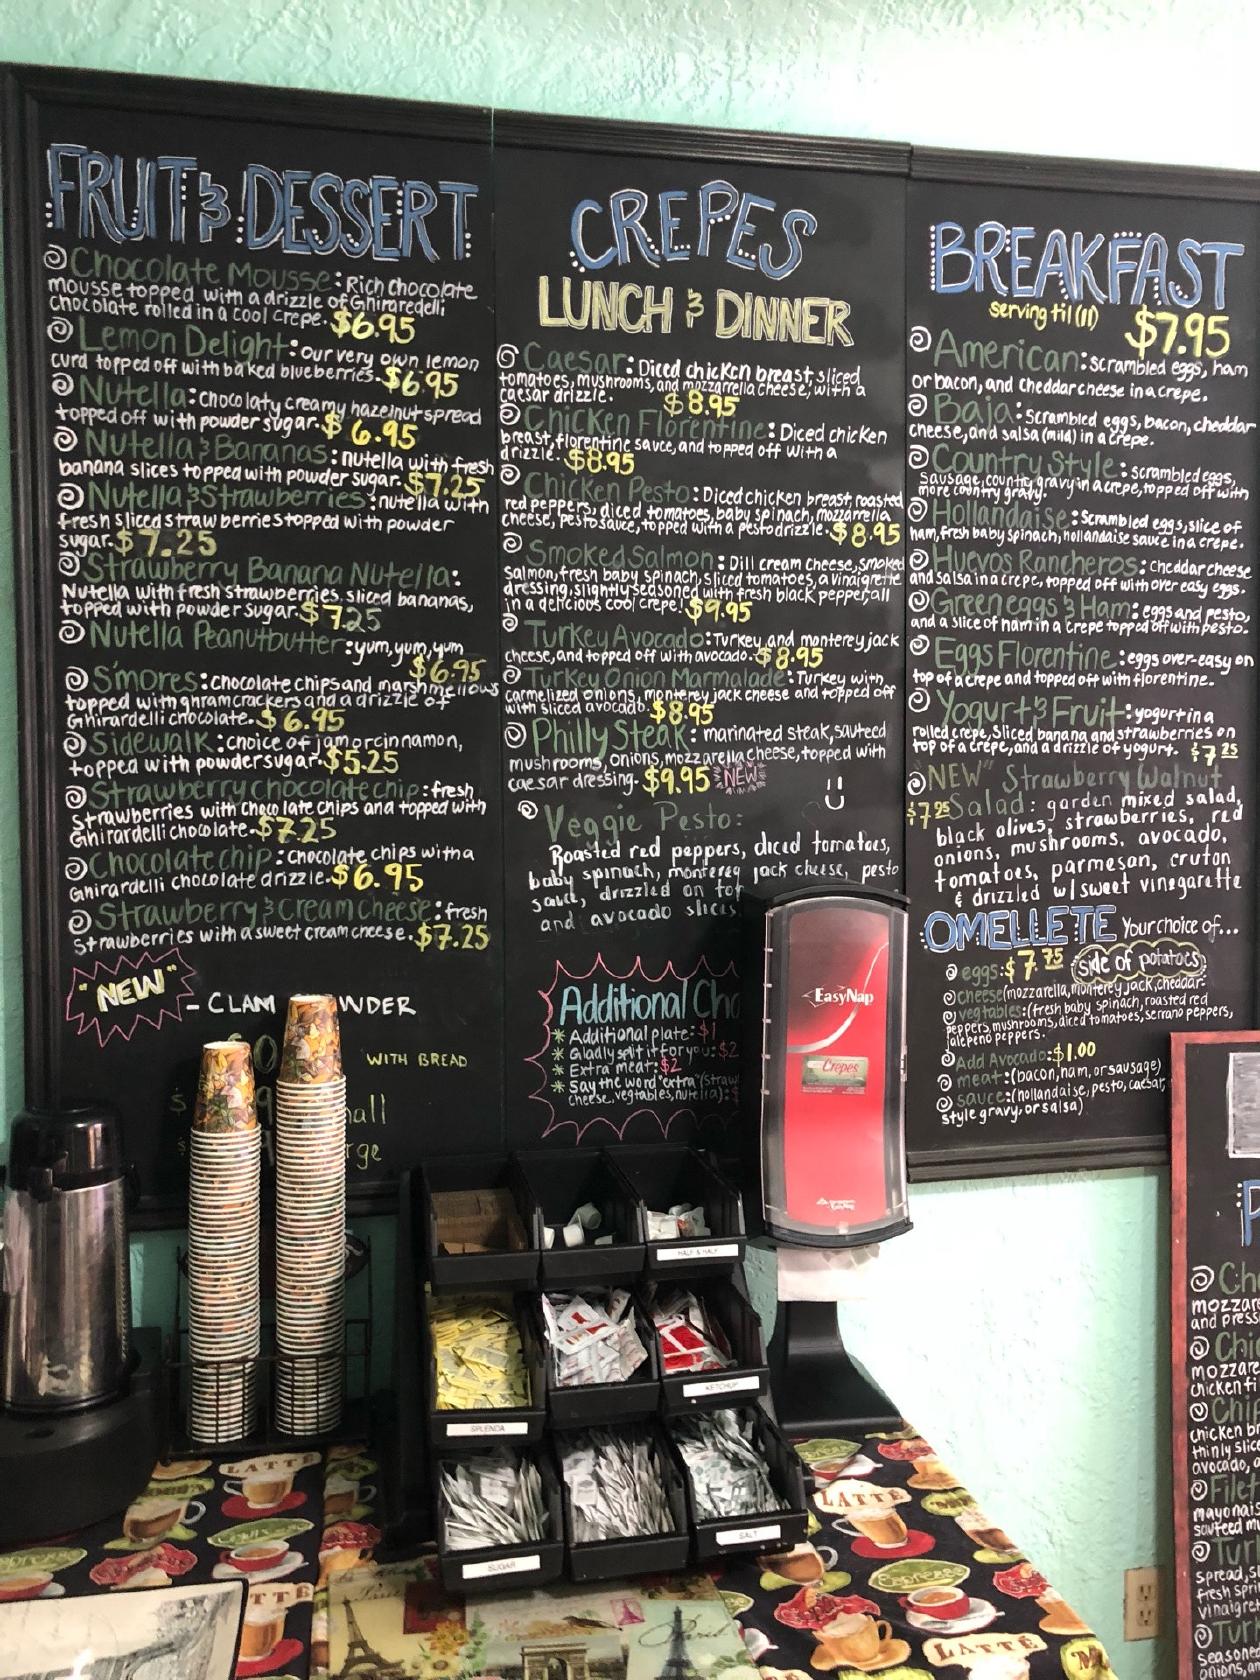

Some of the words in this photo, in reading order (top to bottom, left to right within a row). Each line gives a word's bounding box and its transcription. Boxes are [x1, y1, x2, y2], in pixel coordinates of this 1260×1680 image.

[46, 143, 198, 244] FRUIT
[240, 162, 479, 263] DESSERT
[569, 179, 817, 281] CREPES
[70, 246, 220, 286] Chocolate
[346, 275, 385, 295] Rich
[388, 276, 479, 300] chocolate
[932, 220, 1245, 310] BREAKFAST
[50, 294, 140, 317] chocolate
[330, 307, 416, 344] $6.95
[538, 275, 674, 334] LUNCH
[716, 288, 855, 346] DINNER
[989, 301, 1048, 331] serving
[1050, 303, 1072, 325] til
[79, 315, 176, 354] Lemon
[337, 348, 374, 369] very
[426, 354, 480, 371] lemon
[1124, 303, 1231, 360] $7.95
[51, 353, 88, 370] curd
[96, 354, 150, 375] topped
[380, 364, 460, 400] $6.95
[639, 358, 682, 378] Diced
[685, 361, 752, 381] chicken
[1212, 360, 1249, 378] ham
[1019, 377, 1076, 396] cheddar
[1077, 381, 1125, 397] cheese
[285, 397, 346, 423] creamy
[663, 388, 741, 418] $8.95
[524, 404, 629, 437] Chicken
[86, 428, 193, 460] Nutella
[451, 456, 495, 476] fresh
[564, 447, 635, 475] $8.95
[932, 442, 1043, 476] Country
[1131, 465, 1201, 484] scrambled
[59, 458, 125, 477] banana
[287, 467, 350, 488] powder
[404, 467, 486, 500] $7.25
[524, 472, 621, 504] Chicken
[855, 493, 904, 509] roasted
[89, 479, 182, 511] Nutella
[58, 512, 111, 531] fresh
[114, 512, 162, 529] sliced
[829, 520, 901, 548] $8.95
[1189, 517, 1221, 535] slice
[115, 527, 219, 557] $7.25
[526, 539, 625, 568] Smoked
[730, 555, 754, 571] Dill
[83, 552, 238, 590] Strawberry
[248, 556, 344, 586] Banana
[932, 543, 1013, 574] Huevos
[1206, 562, 1252, 580] cheese
[1046, 575, 1091, 593] topped
[539, 597, 602, 613] delicious
[685, 597, 753, 627] $9.95
[930, 586, 1002, 617] Green
[1006, 594, 1058, 625] eggs
[90, 619, 184, 651] Nutella
[524, 619, 609, 651] Turkey
[409, 653, 487, 684] $6.95
[934, 635, 994, 679] Eggs
[210, 673, 292, 694] chocolate
[522, 666, 600, 689] Turkey
[604, 666, 666, 689] Onion
[67, 711, 165, 729] Ghirardelli
[256, 702, 347, 733] $6.95
[936, 688, 1032, 730] Yogurt
[1117, 726, 1213, 741] strawberries
[531, 717, 609, 760] Philly
[704, 723, 783, 743] marinated
[323, 745, 399, 775] $5.25
[642, 765, 711, 798] $9.95
[724, 766, 758, 787] NEW
[1002, 760, 1130, 796] Strawberry
[1137, 762, 1223, 790] Walnut
[90, 778, 246, 811] Strawberry
[250, 777, 369, 801] chocolate
[1121, 789, 1175, 808] mixed
[543, 803, 643, 847] Veggie
[936, 821, 986, 847] black
[1211, 803, 1244, 823] red
[89, 844, 214, 880] Chocolate
[331, 863, 424, 893] $6.95
[549, 838, 621, 877] Roasted
[754, 830, 801, 856] diced
[1169, 843, 1231, 867] cruton
[972, 882, 1041, 907] drizzled
[1080, 871, 1131, 898] sweet
[1140, 866, 1242, 900] vinegarette
[95, 897, 258, 932] Strawberry
[278, 896, 354, 923] Cream
[590, 903, 672, 927] avocado
[922, 904, 1118, 953] OMELLETE
[1121, 915, 1157, 939] Your
[1157, 915, 1199, 935] choice
[414, 921, 491, 952] $7.25
[1138, 948, 1200, 972] potatoes
[207, 992, 277, 1015] CLAM
[338, 995, 417, 1016] WDER
[559, 979, 688, 1026] Additional
[815, 986, 875, 1006] EasyNap
[1145, 991, 1187, 1007] roasted
[569, 1024, 648, 1045] Additional
[366, 1052, 408, 1067] WITH
[417, 1052, 468, 1067] BREAD
[570, 1062, 610, 1078] Extra
[660, 1054, 683, 1076] $2
[822, 1057, 860, 1074] Crepes
[955, 1053, 985, 1072] Add
[1051, 1041, 1096, 1068] $1.00
[1191, 1313, 1217, 1331] and
[1190, 1380, 1242, 1397] chicken
[1190, 1425, 1243, 1444] chicken
[226, 1453, 317, 1475] LATTE
[1192, 1444, 1232, 1461] thinly
[821, 1488, 906, 1508] LATTE
[1196, 1584, 1232, 1604] fresh
[933, 1635, 1039, 1661] LATTE
